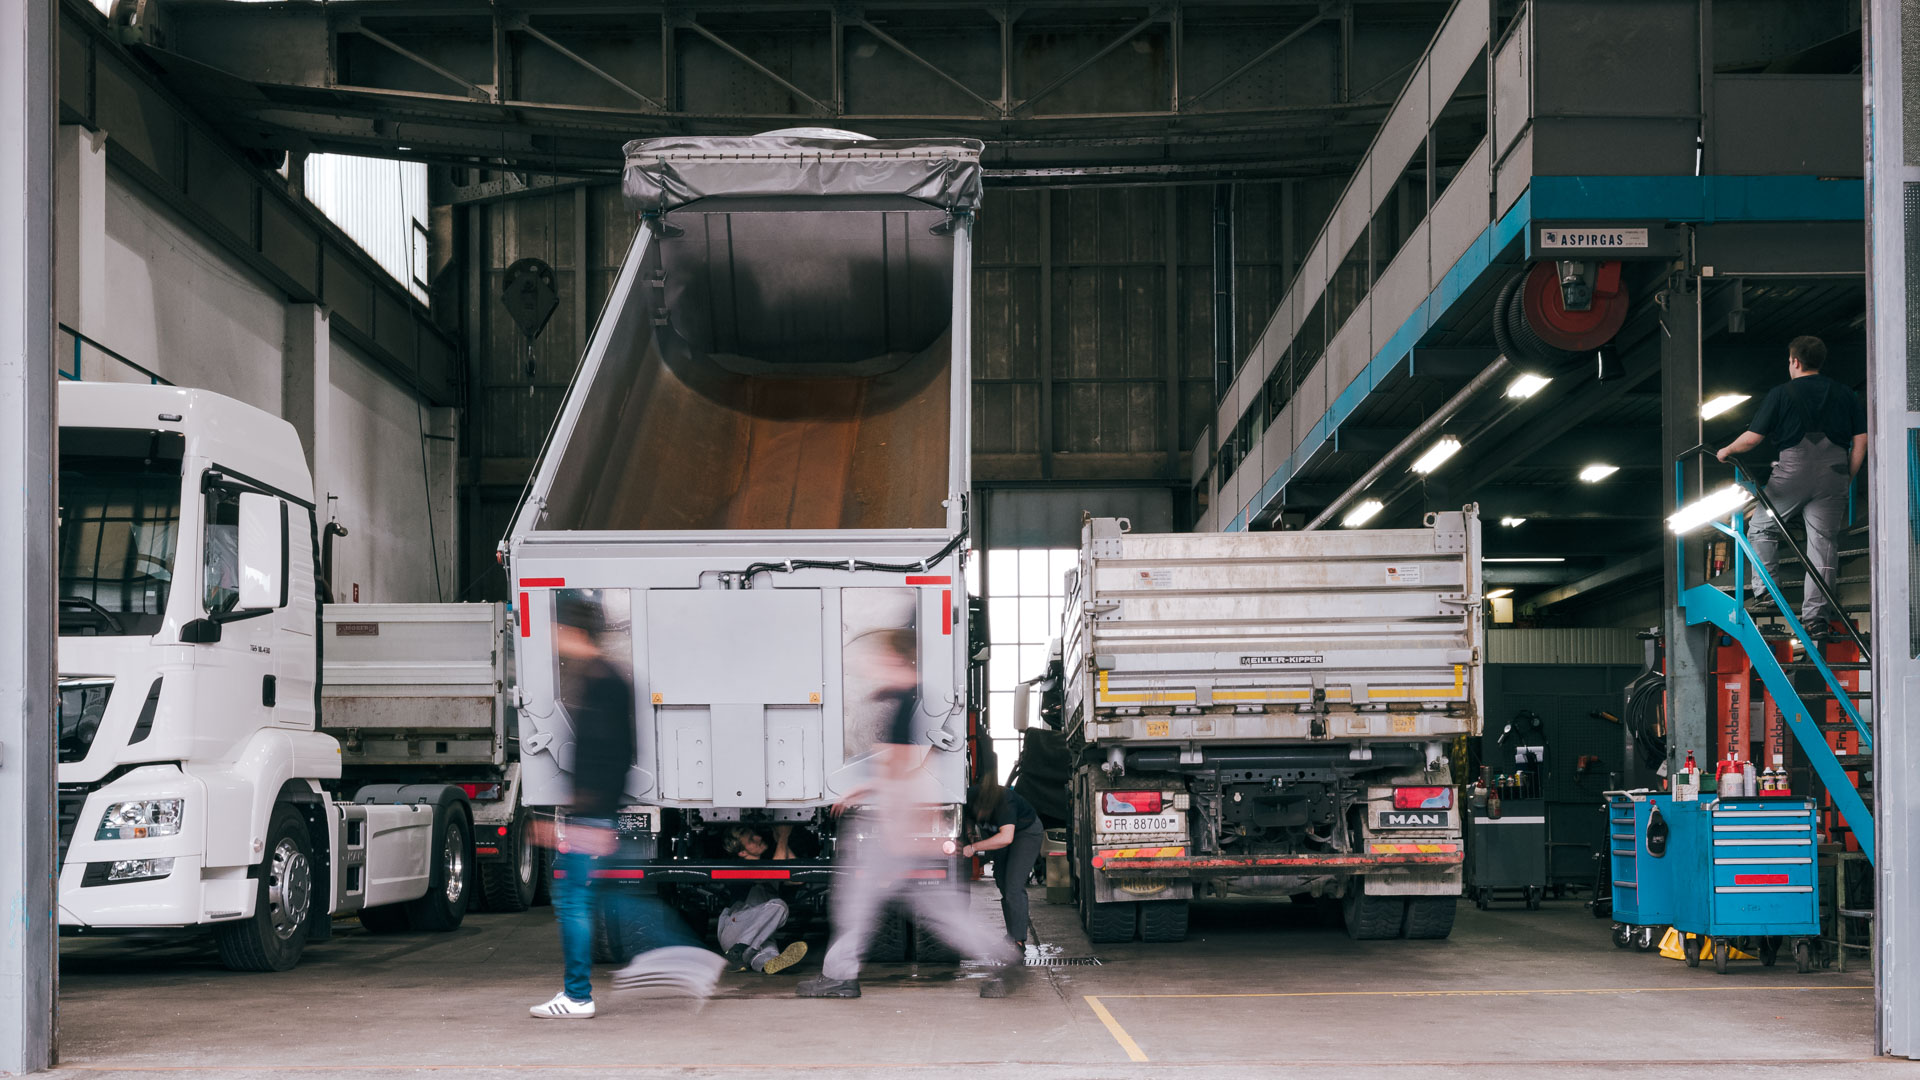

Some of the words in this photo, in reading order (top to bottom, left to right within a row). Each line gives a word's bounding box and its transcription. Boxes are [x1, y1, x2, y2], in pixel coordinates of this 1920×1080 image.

[1561, 234, 1624, 246] ASPIRGAS
[1241, 656, 1323, 665] MEILLER-KIPPER
[1725, 689, 1739, 753] Finkbeiner
[1770, 704, 1784, 754] Finkbein
[1389, 814, 1439, 825] MAN
